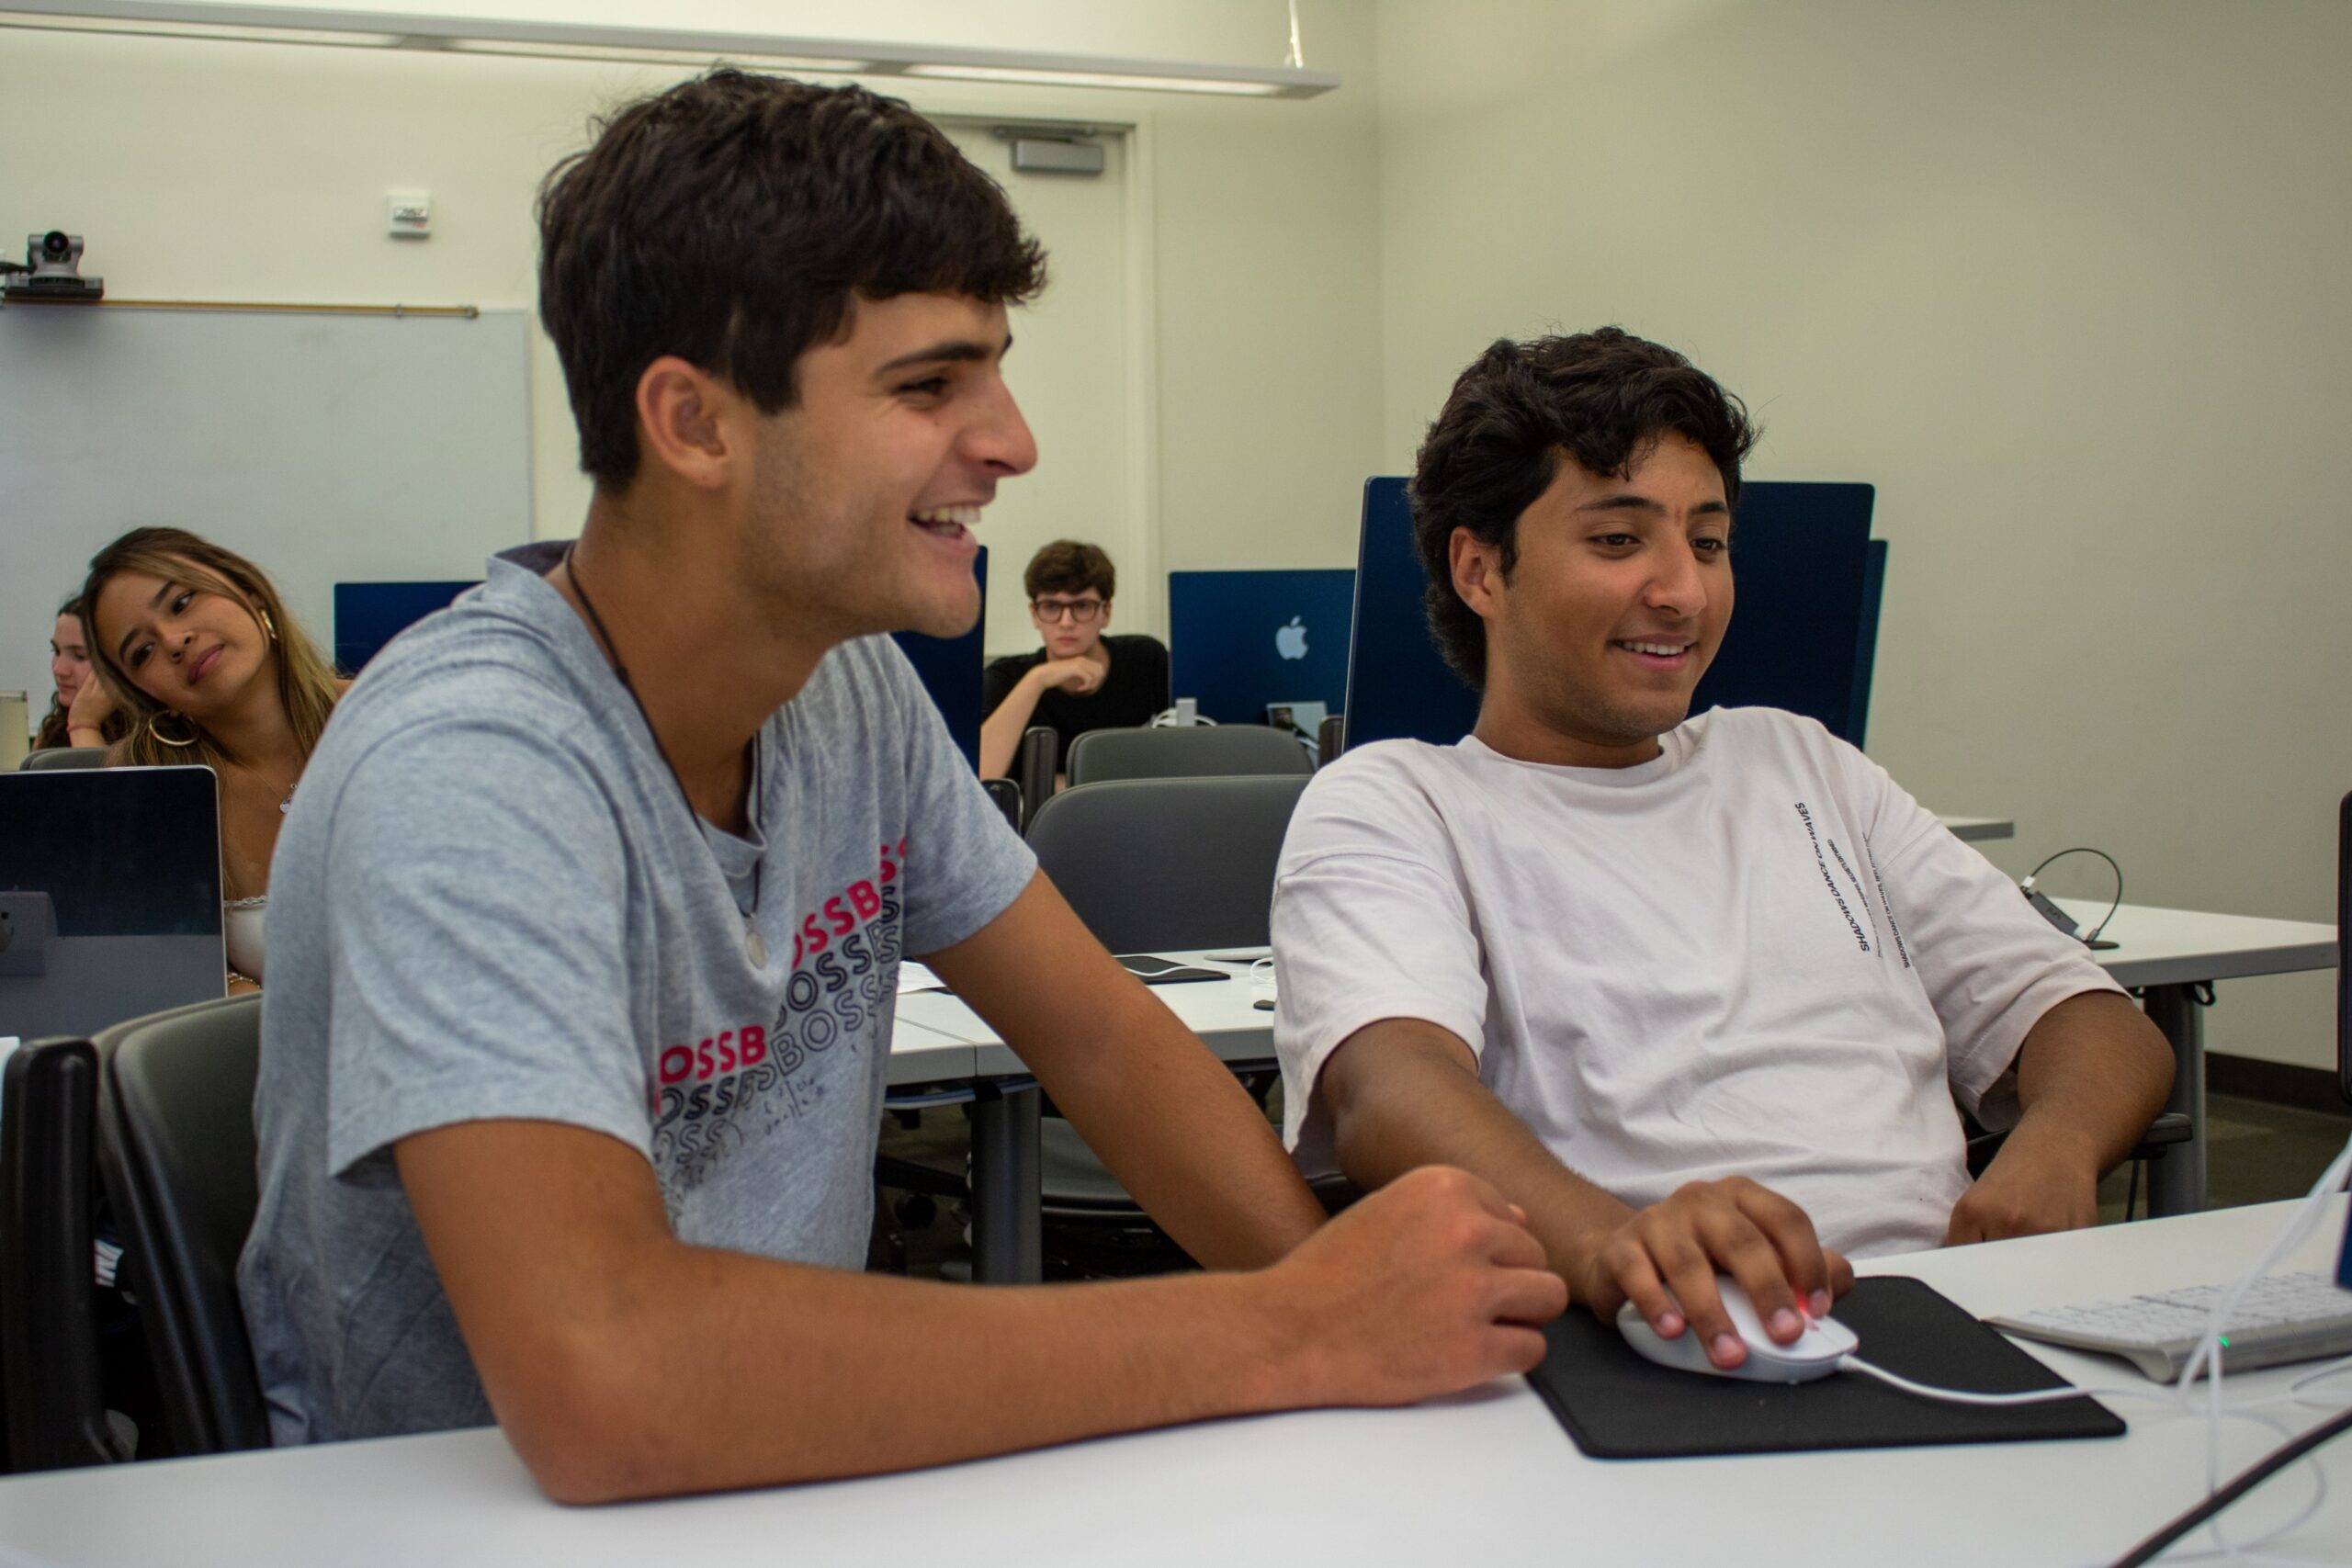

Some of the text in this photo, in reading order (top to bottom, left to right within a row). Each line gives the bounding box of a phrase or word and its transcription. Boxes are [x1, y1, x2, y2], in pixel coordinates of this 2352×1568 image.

[1794, 802, 1871, 952] SHADOWS DANCE ON WAVES
[1894, 935, 1911, 968] SHADOWS
